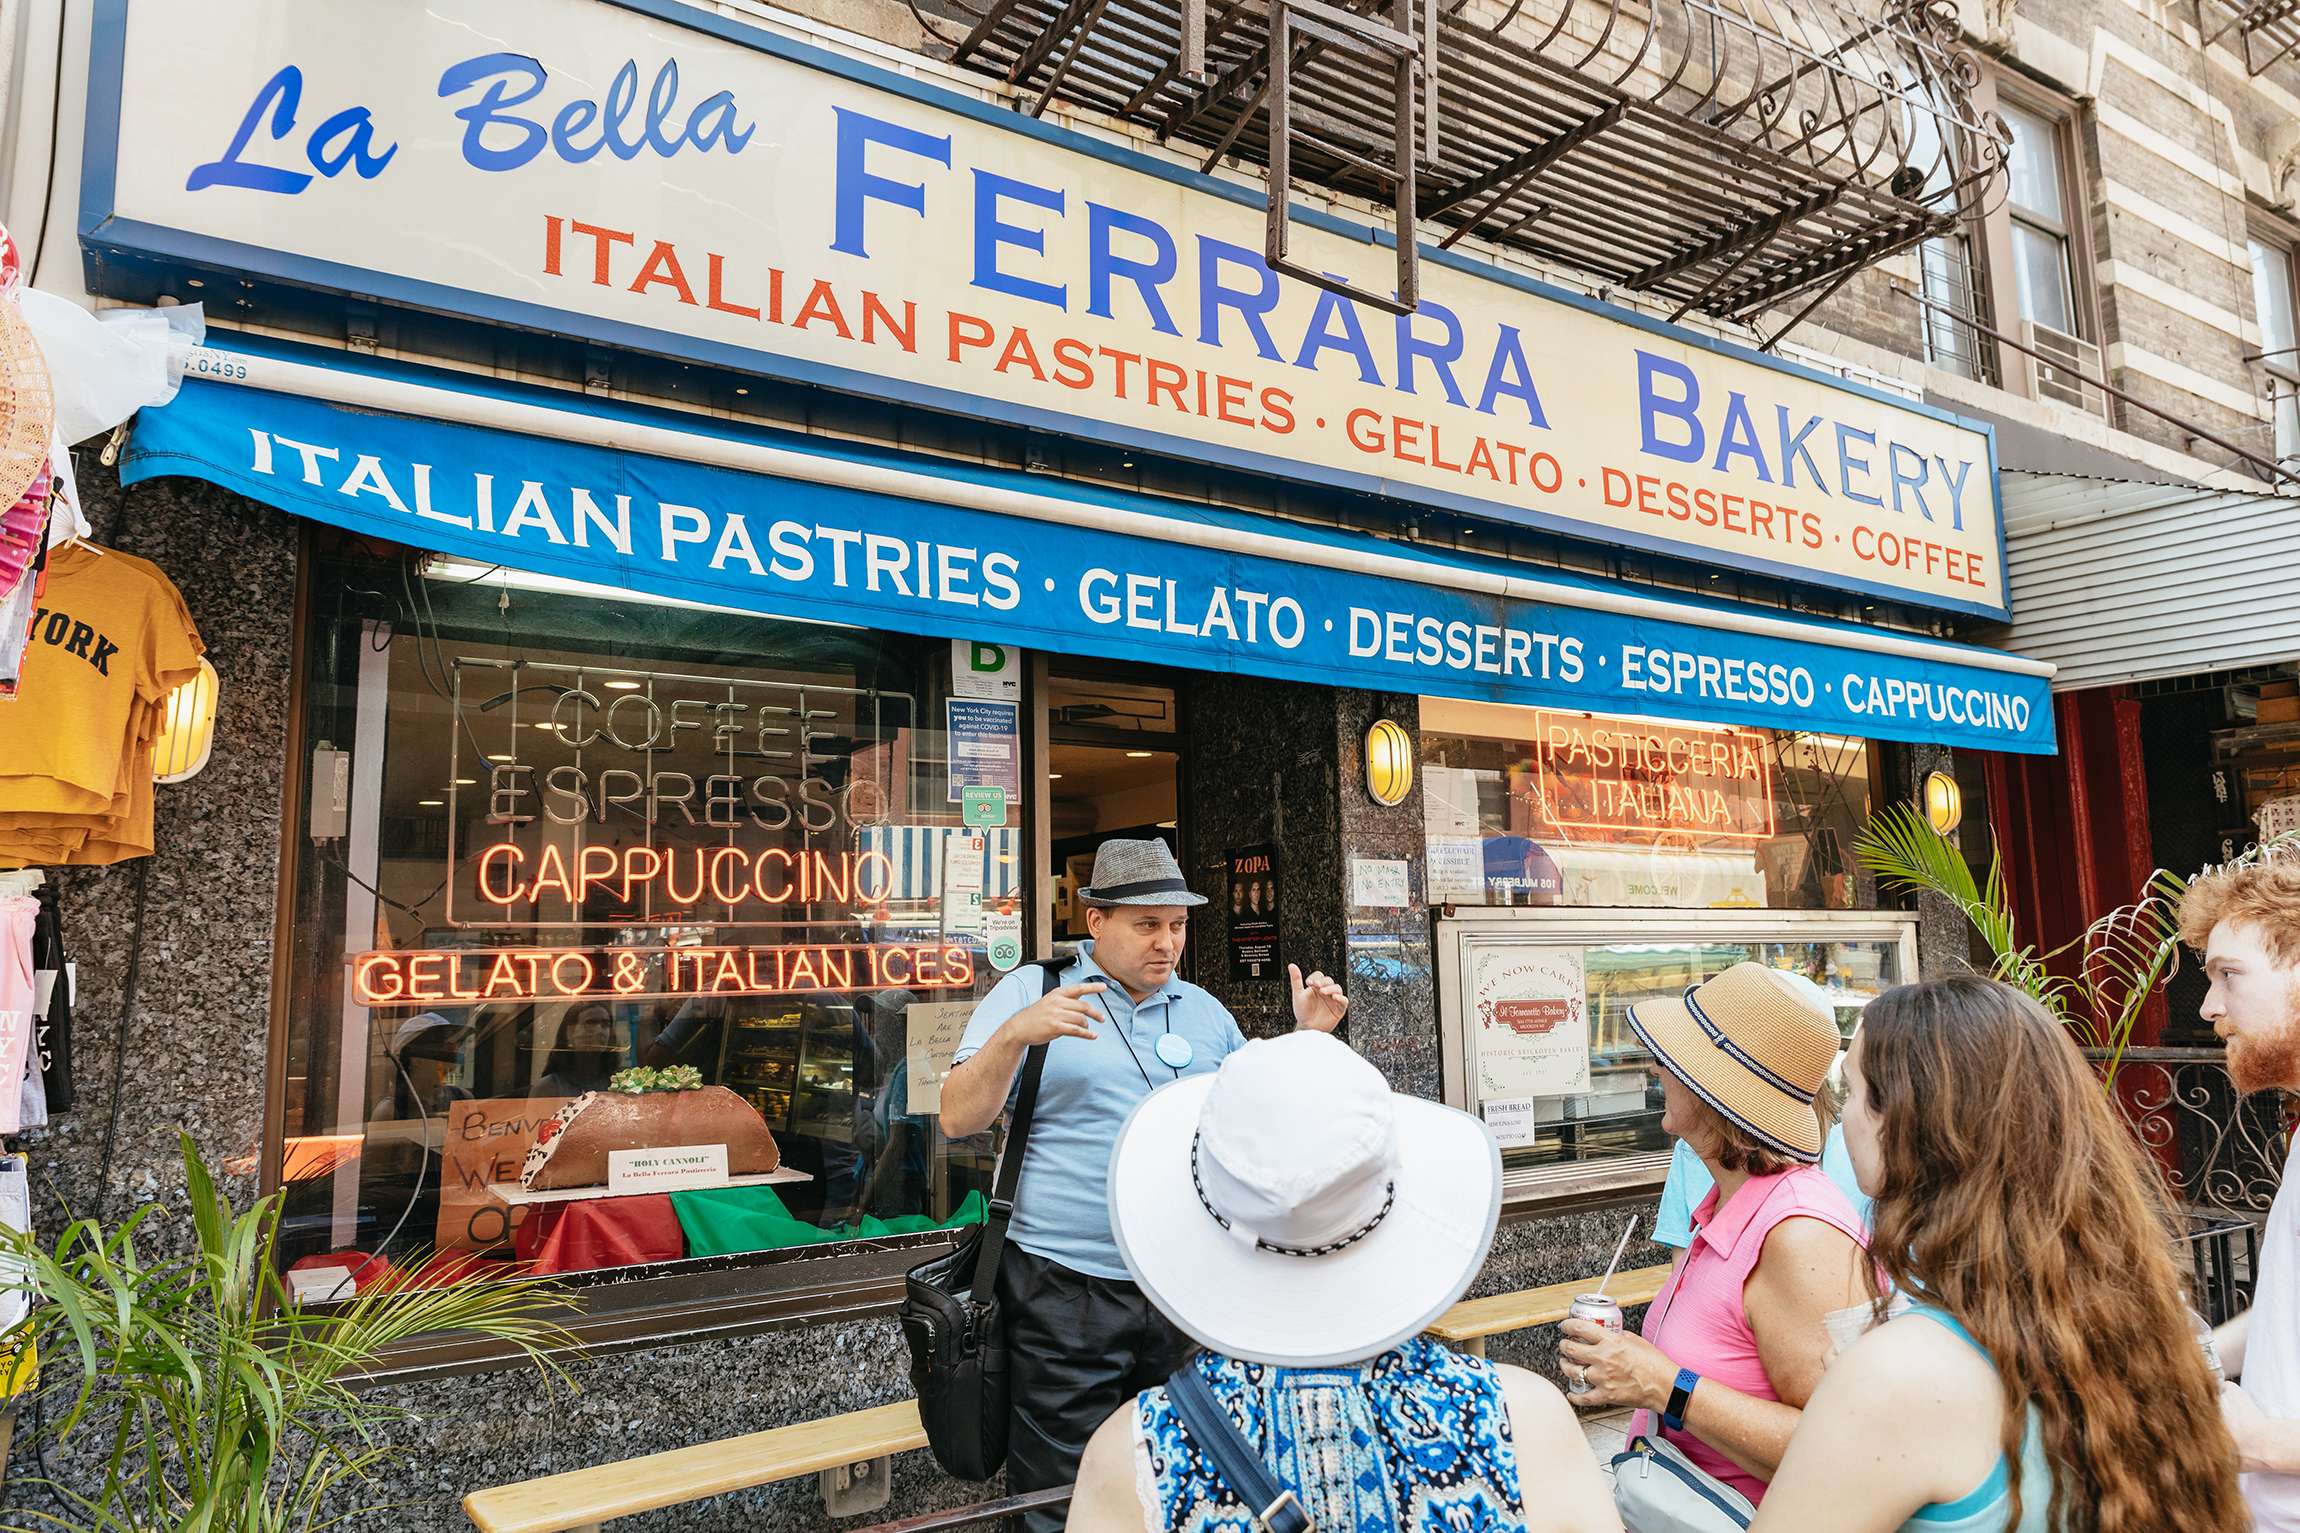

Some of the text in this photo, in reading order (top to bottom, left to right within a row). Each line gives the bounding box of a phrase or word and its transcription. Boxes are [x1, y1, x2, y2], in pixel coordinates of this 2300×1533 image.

[186, 53, 756, 195] La Bella
[831, 105, 1973, 531] FERRARA BAKERY
[185, 359, 247, 379] .0499
[544, 214, 1986, 588] ITALIAN PASTRIES GELATO DESSERTS COFFEE
[249, 428, 2030, 732] ITALIAN PASTRIES GELATO DESSERTS ESPRESSO CAPPUCCINO
[551, 688, 841, 761] COFFEE
[967, 706, 980, 714] York
[980, 708, 991, 716] City
[980, 723, 1009, 731] COVID-19
[1547, 725, 1761, 781] PASTICCERIA
[486, 764, 891, 831] ESPRESSO
[965, 791, 992, 800] REVIEW
[1591, 779, 1732, 825] ITALIANA
[479, 842, 894, 905] CAPPUCCINO
[1235, 855, 1271, 874] ZOPA
[358, 946, 971, 1001] GELATO & ITALIAN ICES
[1502, 965, 1535, 979] NOW
[452, 1112, 552, 1141] BENV
[1487, 1102, 1531, 1113] FRESH BREAD
[453, 1152, 517, 1191] WE
[467, 1203, 531, 1244] OP
